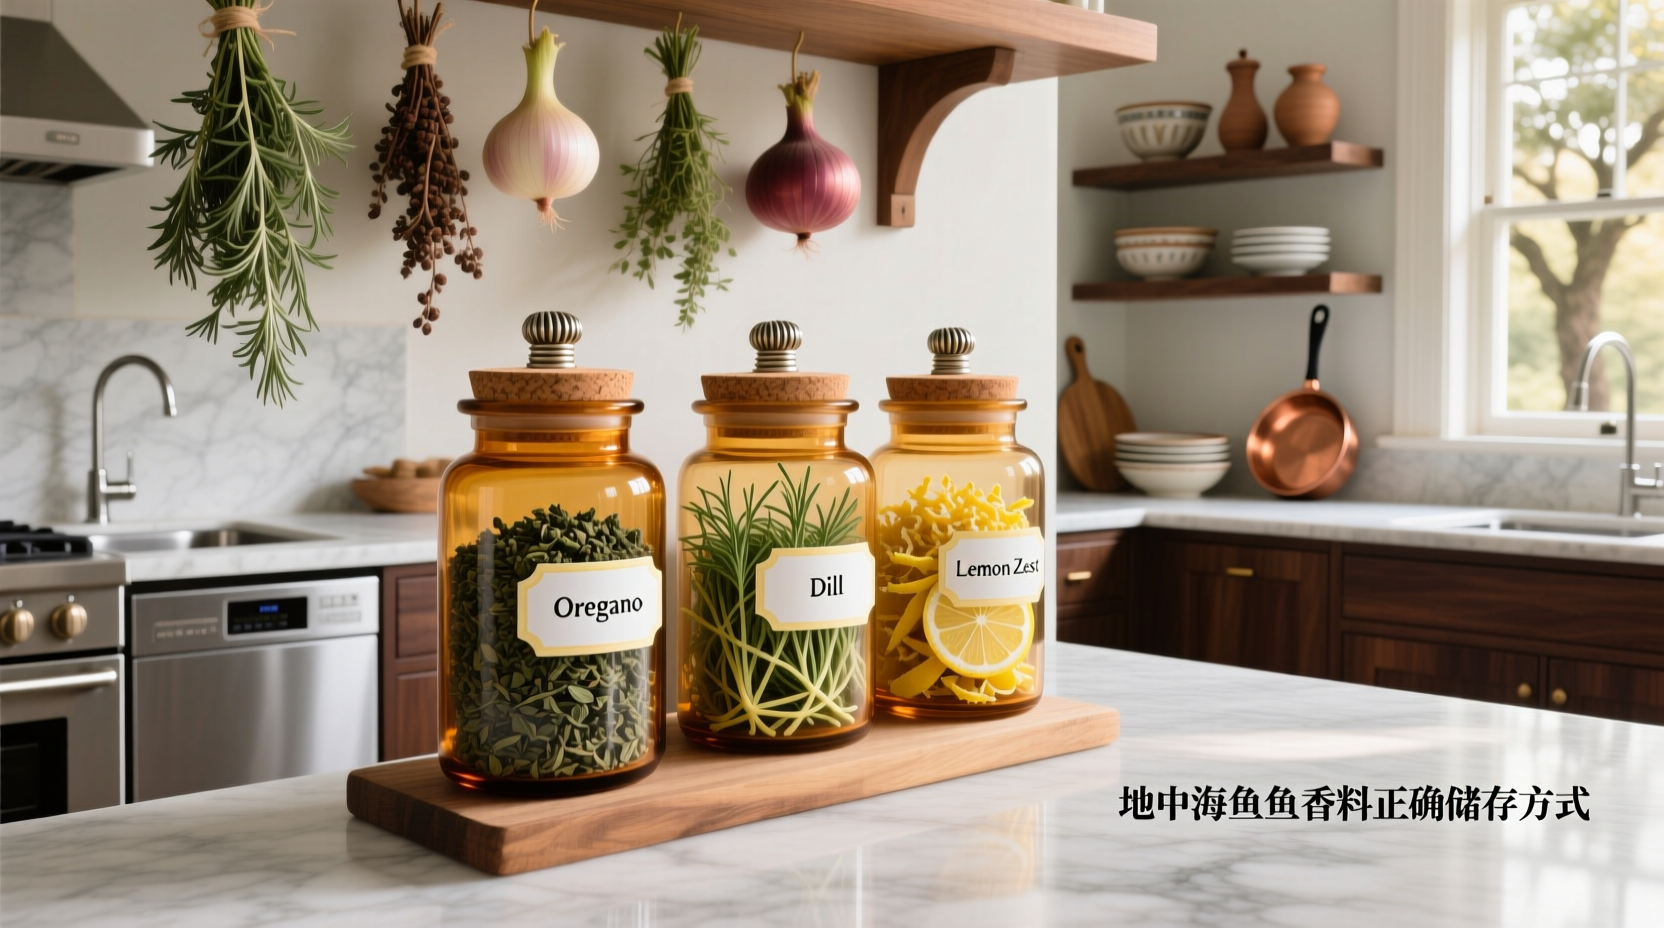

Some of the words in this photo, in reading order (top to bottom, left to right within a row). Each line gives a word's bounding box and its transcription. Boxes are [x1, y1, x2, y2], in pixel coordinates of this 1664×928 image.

[956, 559, 1011, 577] Lemon
[1013, 557, 1039, 575] Zest
[810, 574, 844, 598] Dill
[553, 595, 643, 623] Oregano
